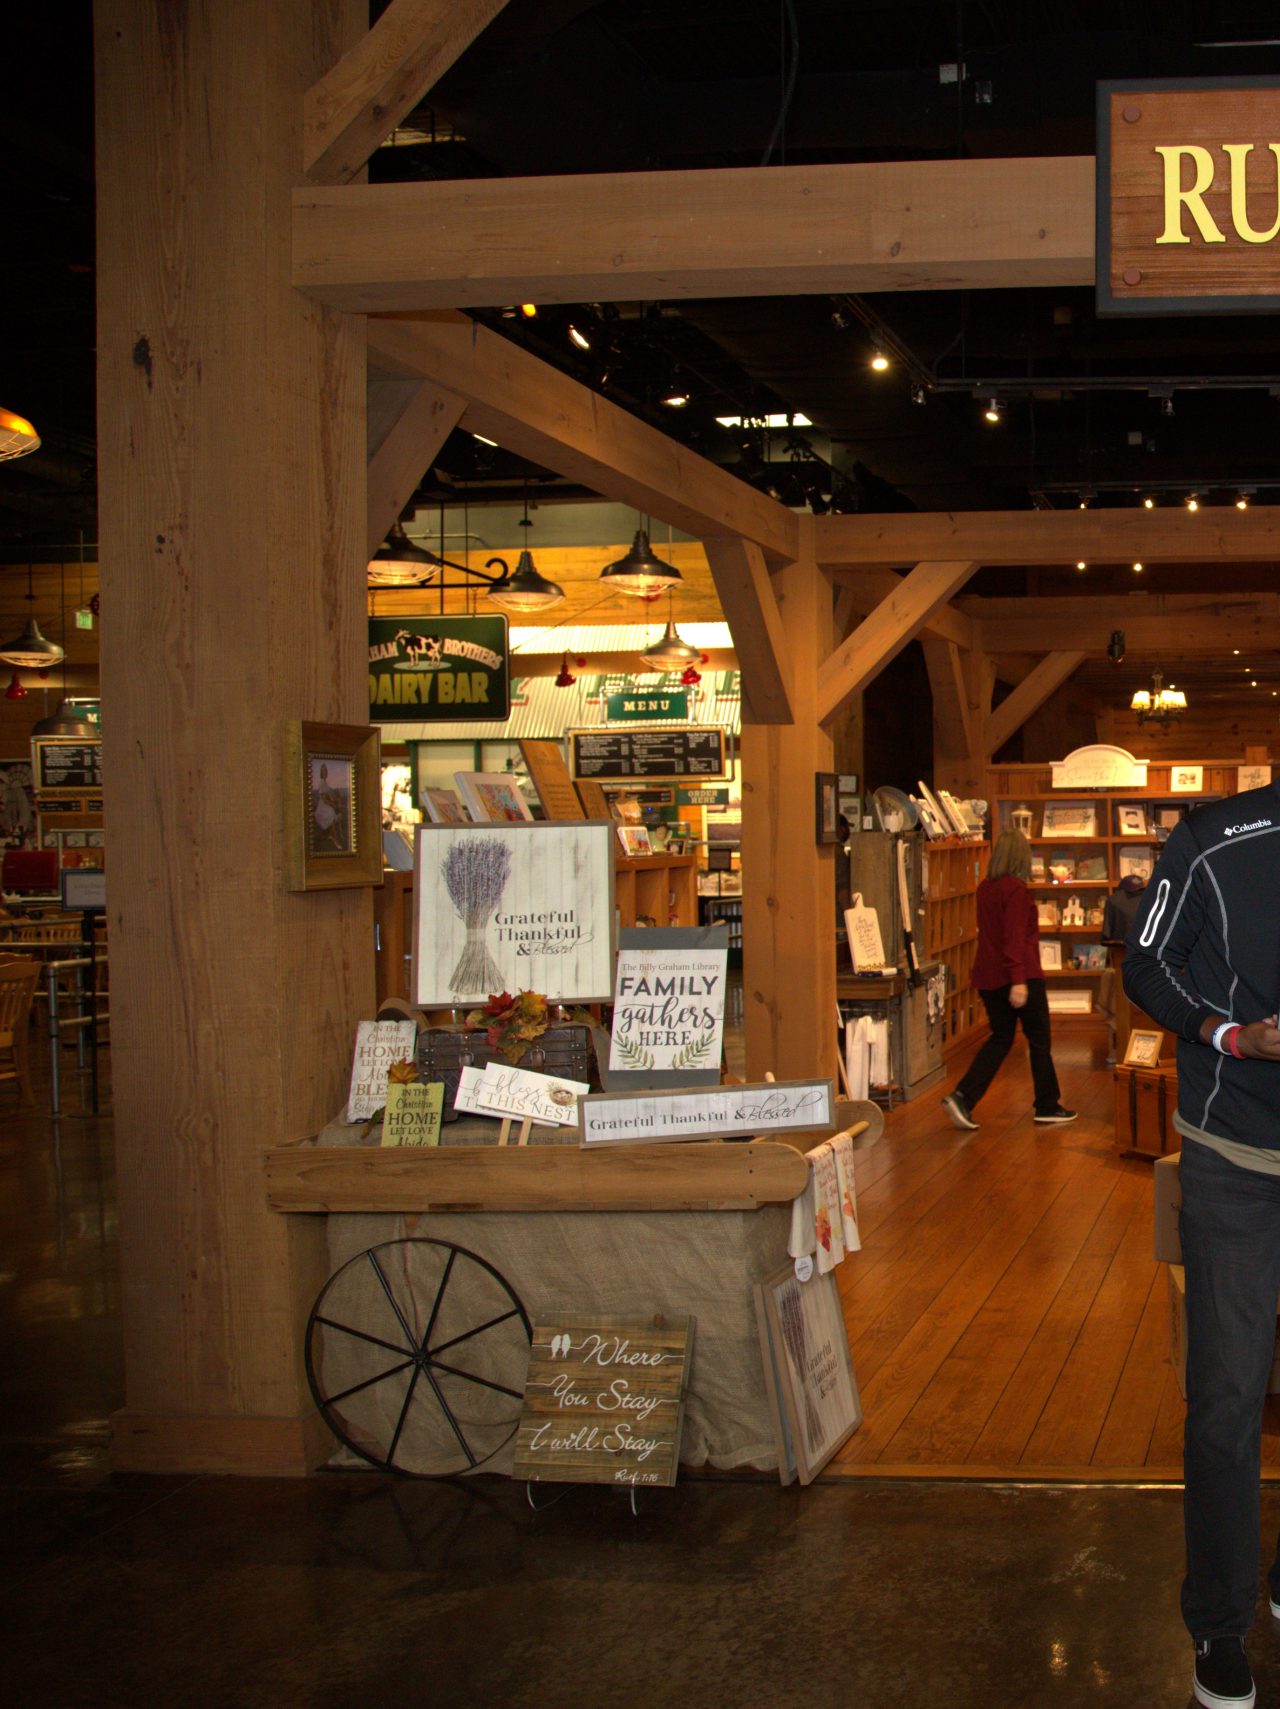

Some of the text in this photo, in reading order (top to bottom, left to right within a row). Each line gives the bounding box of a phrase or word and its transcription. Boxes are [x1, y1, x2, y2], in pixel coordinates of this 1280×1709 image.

[437, 672, 489, 704] BAR
[624, 700, 671, 712] MENU
[688, 790, 718, 798] ORDER
[1233, 818, 1272, 835] Columbia
[495, 910, 574, 925] Grateful
[494, 925, 581, 942] Thankful
[516, 943, 531, 956] &
[623, 962, 721, 973] The Billy Graham Library
[620, 976, 719, 996] FAMILY
[617, 996, 719, 1034] gathers
[638, 1031, 691, 1047] HERE
[360, 1046, 411, 1058] HOME
[414, 1088, 430, 1096] THE
[487, 1092, 575, 1121] THIS NEST
[590, 1091, 823, 1131] Grateful Thankful & Blessed
[388, 1112, 438, 1125] HOME
[390, 1127, 433, 1135] LET LOVE
[580, 1334, 670, 1366] Where
[551, 1374, 664, 1421] You Stay
[551, 1427, 599, 1450] will
[602, 1423, 665, 1462] Stay
[614, 1469, 658, 1483] Ruth 1:16
